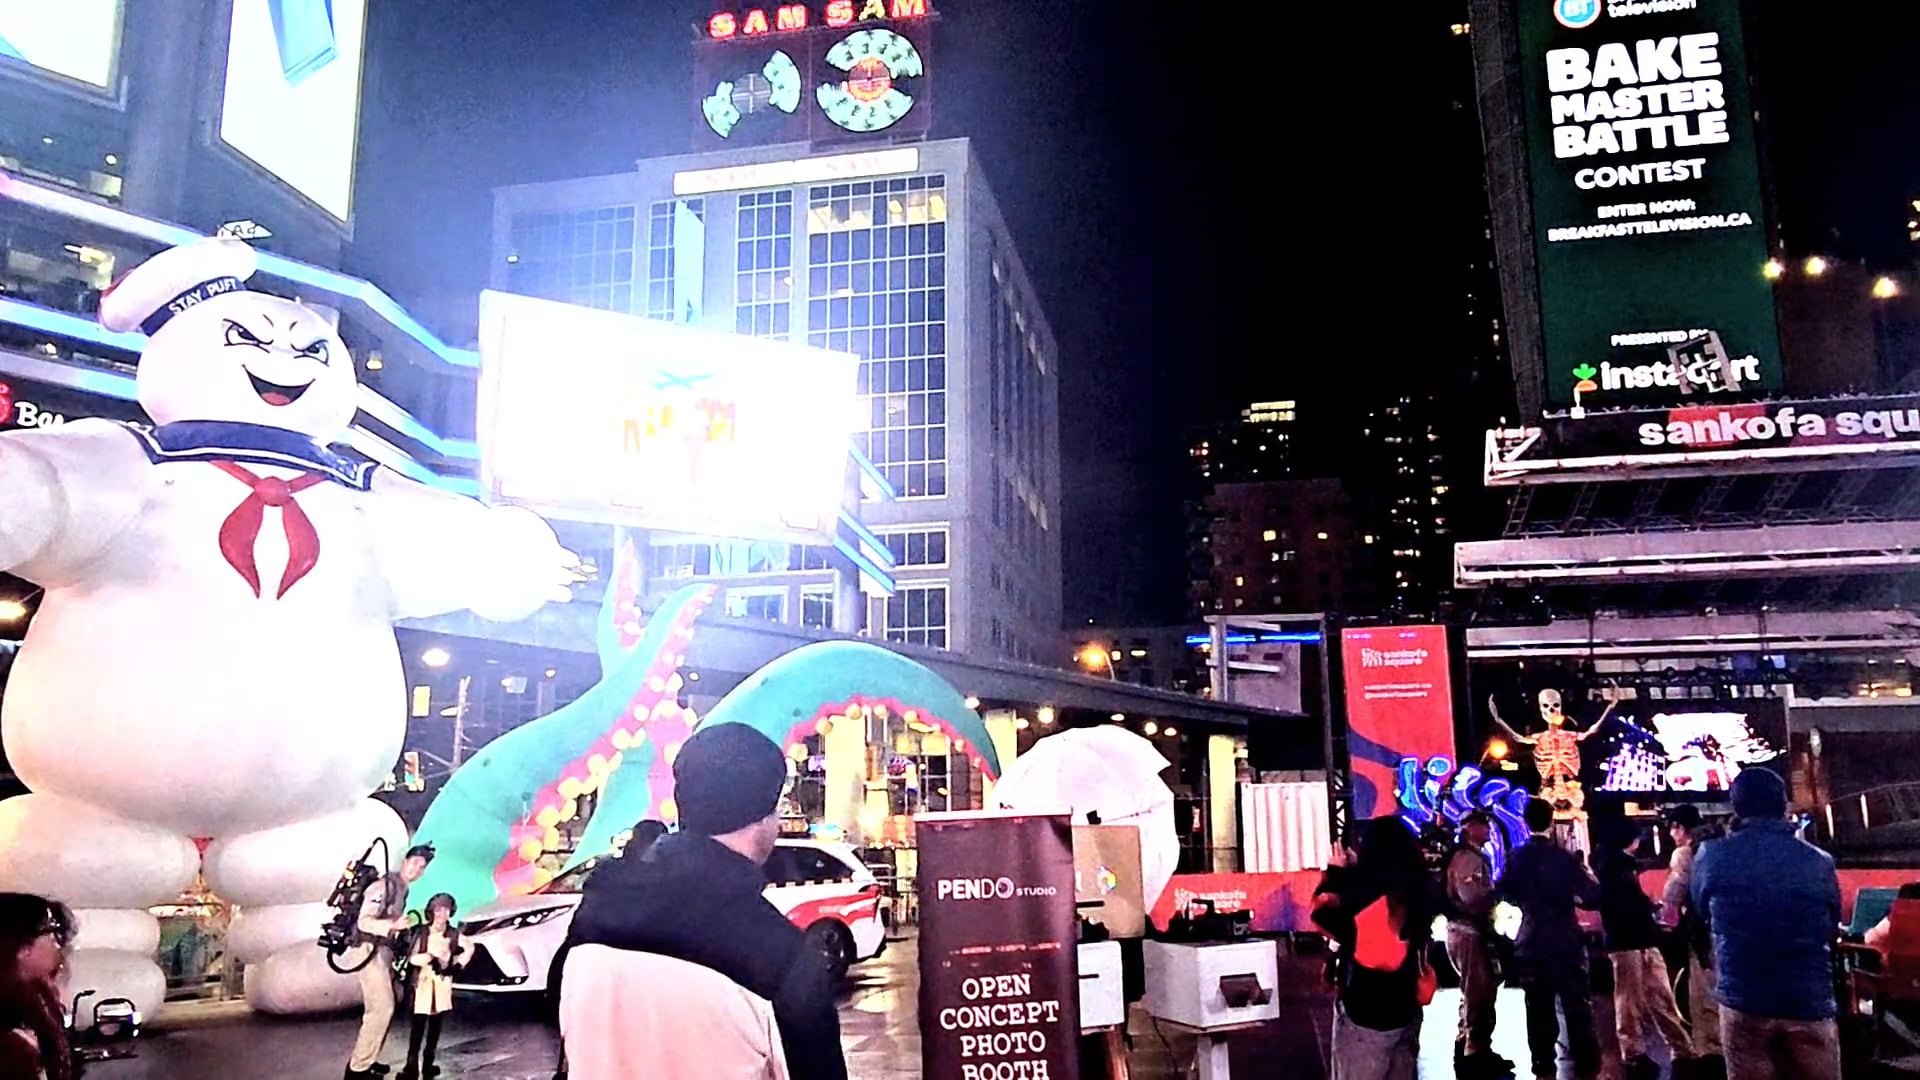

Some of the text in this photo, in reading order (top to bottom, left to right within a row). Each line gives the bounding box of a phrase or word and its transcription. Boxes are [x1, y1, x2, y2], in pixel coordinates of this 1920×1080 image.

[708, 0, 928, 39] SAM SAM
[1546, 32, 1722, 92] BAKE
[1550, 79, 1726, 125] MASTER
[1553, 110, 1730, 159] BATTLE
[1574, 158, 1707, 190] CONTEST
[1597, 199, 1697, 219] ENTER NOW:
[1548, 212, 1753, 242] BREAKFASTTELEVISION.CA
[168, 278, 238, 314] STAY PUFT
[1610, 330, 1689, 347] PRESENTED
[1638, 407, 1920, 446] sankofa squ
[938, 877, 1057, 900] PENDO STUDIO
[962, 974, 1031, 1000] OPEN
[940, 1000, 1059, 1030] CONCEPT
[960, 1030, 1046, 1057] PHOTO
[961, 1060, 1050, 1080] BOOTH
